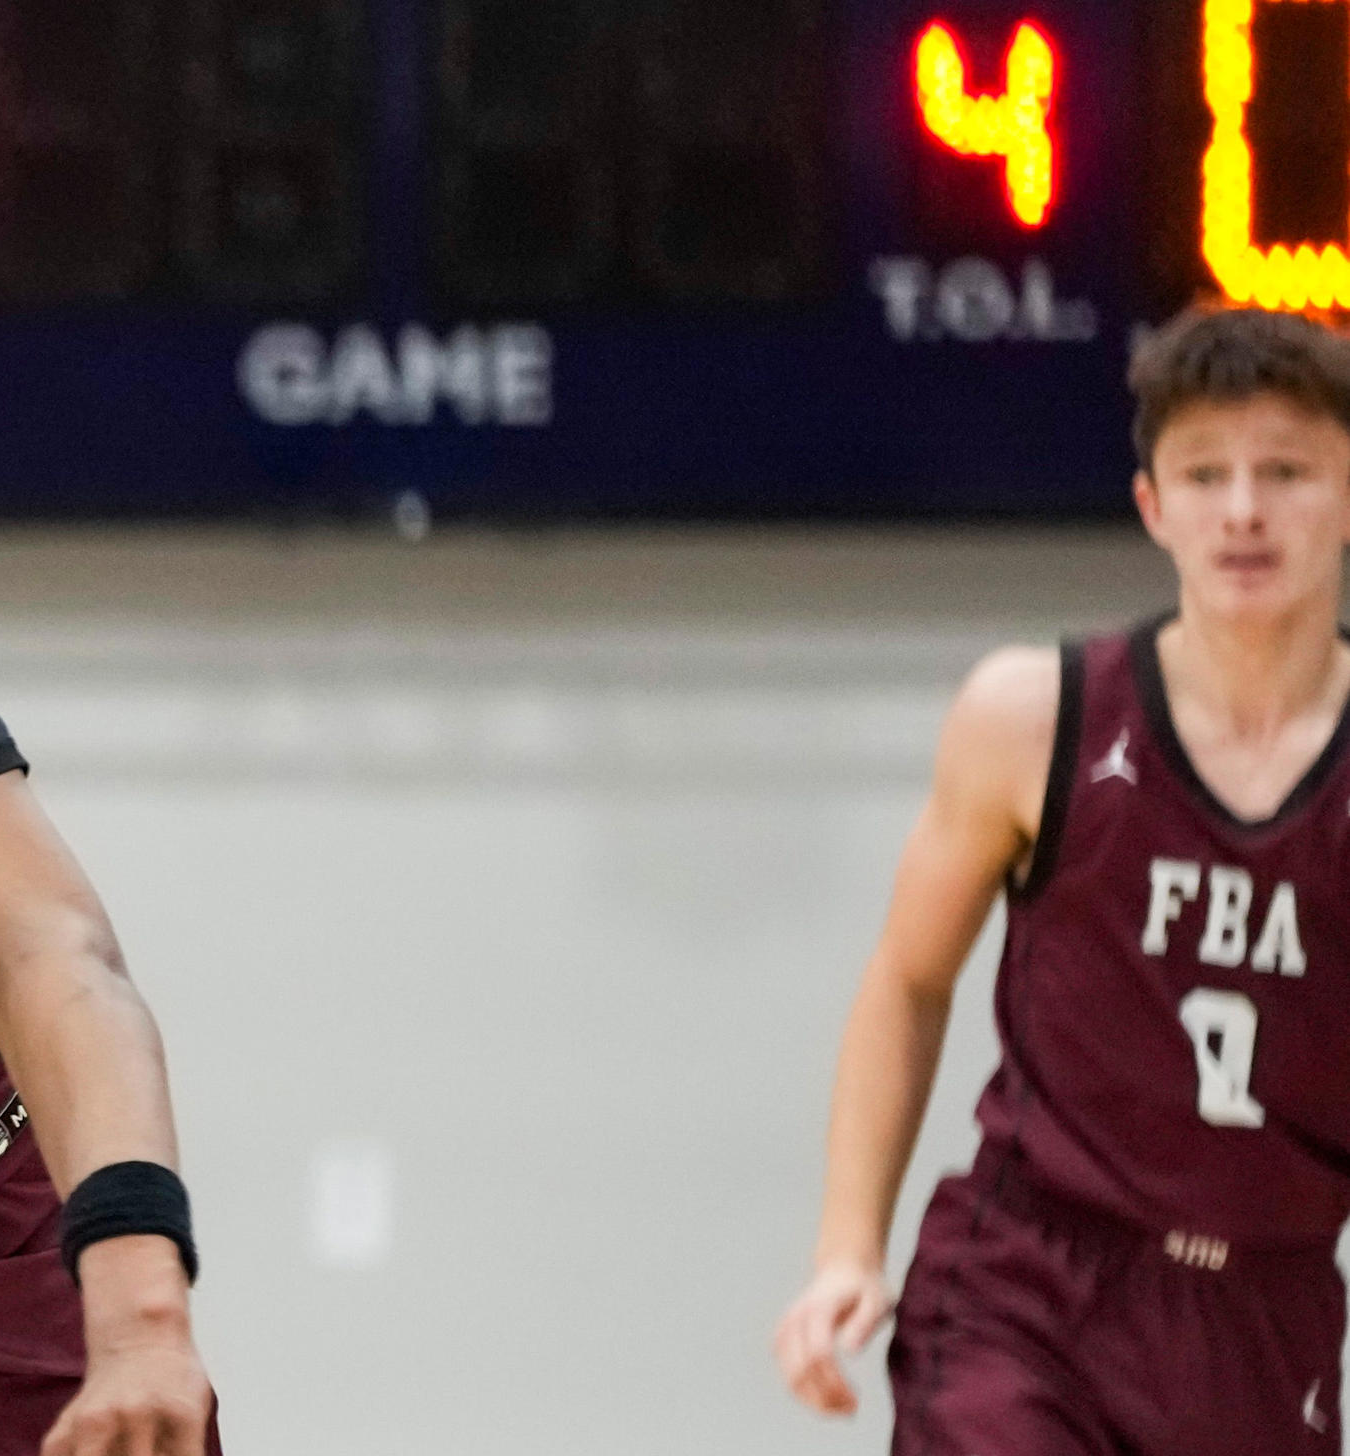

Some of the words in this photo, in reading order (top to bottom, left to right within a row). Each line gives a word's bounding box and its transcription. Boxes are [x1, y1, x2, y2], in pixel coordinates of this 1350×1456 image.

[915, 20, 1055, 227] 4
[239, 323, 552, 425] GAME
[1141, 857, 1307, 977] FBA
